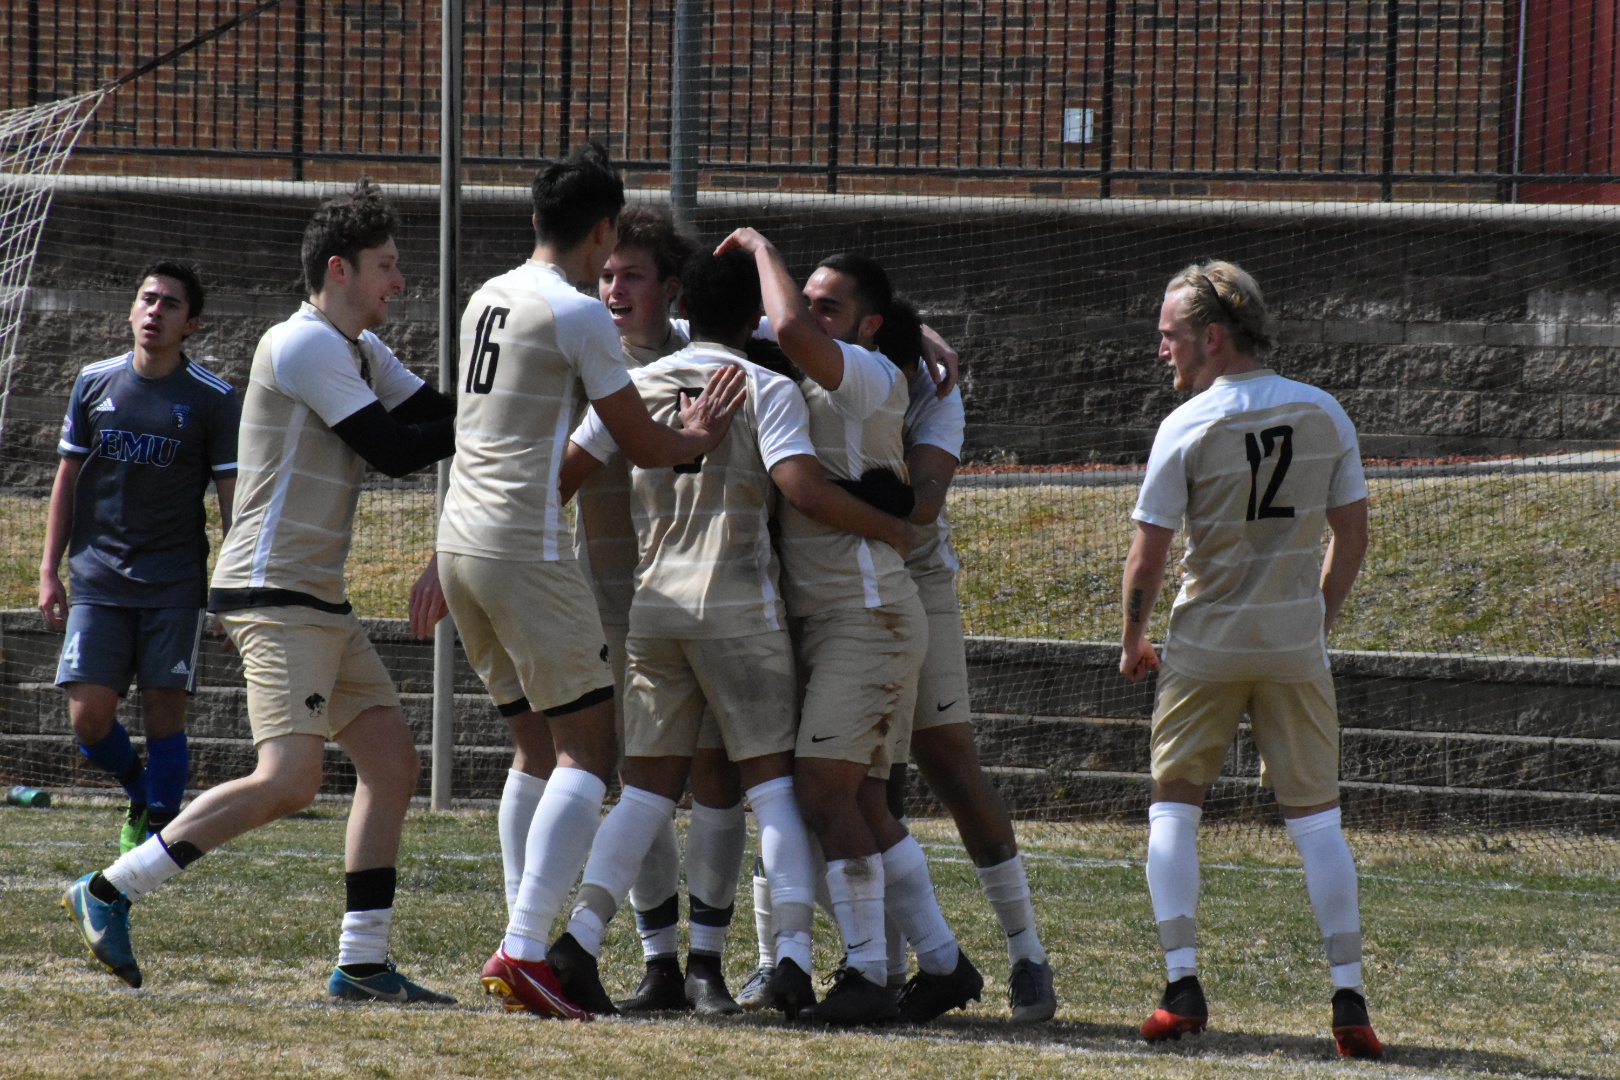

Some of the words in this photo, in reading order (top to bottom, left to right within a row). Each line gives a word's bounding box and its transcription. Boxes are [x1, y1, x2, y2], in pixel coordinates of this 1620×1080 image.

[465, 306, 510, 394] 16
[99, 429, 181, 467] EMU
[1245, 425, 1295, 521] 12
[64, 631, 80, 669] 4
